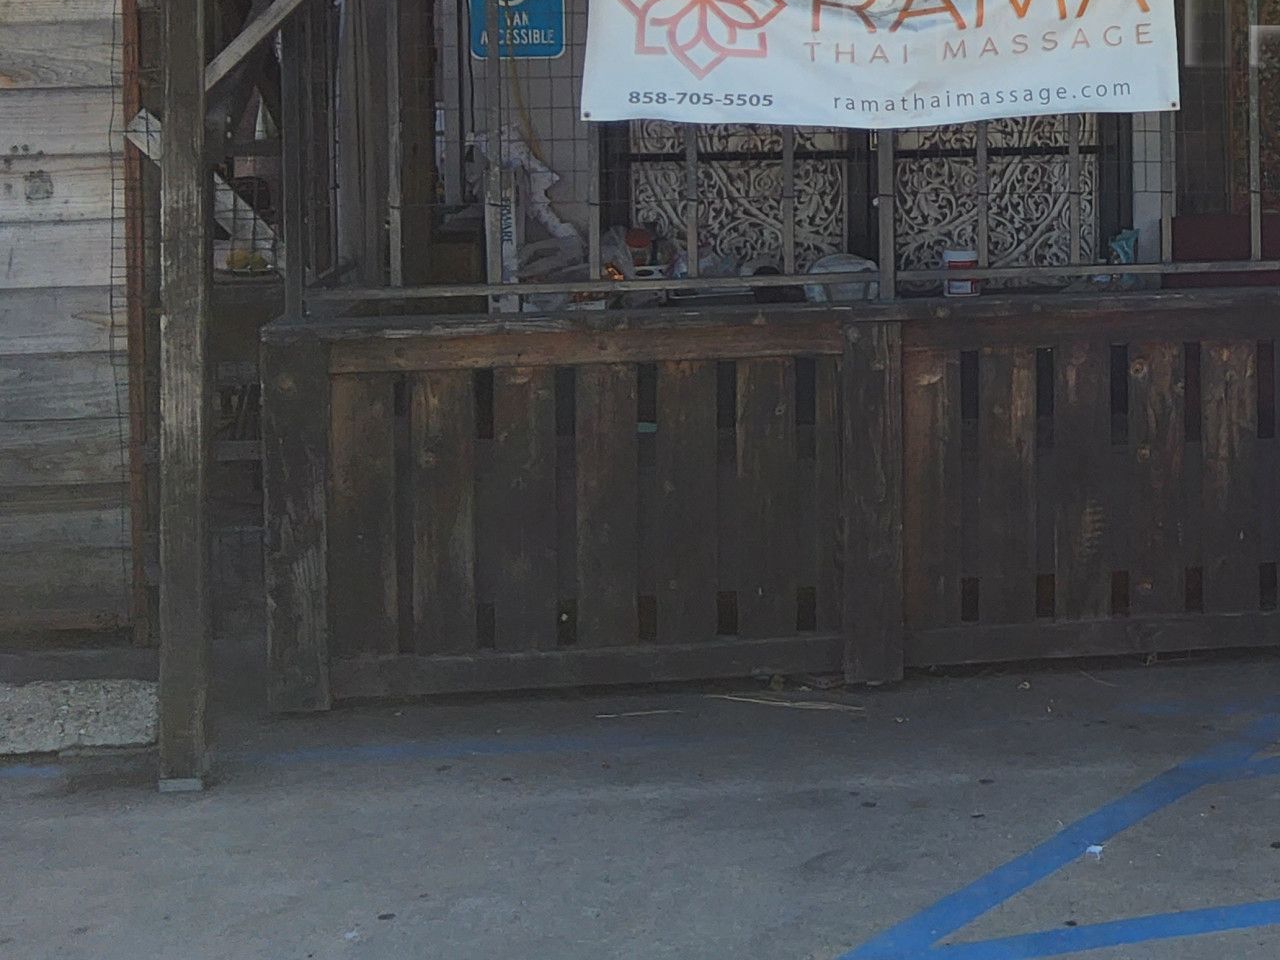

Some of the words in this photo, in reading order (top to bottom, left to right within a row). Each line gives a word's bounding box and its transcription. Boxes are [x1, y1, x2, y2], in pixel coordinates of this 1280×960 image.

[480, 29, 555, 45] ACESSIBLE
[804, 40, 909, 65] THAI
[942, 23, 1154, 61] MASSAGE
[627, 90, 774, 108] 858-705-5505
[833, 81, 1132, 113] ramathaimassage.com
